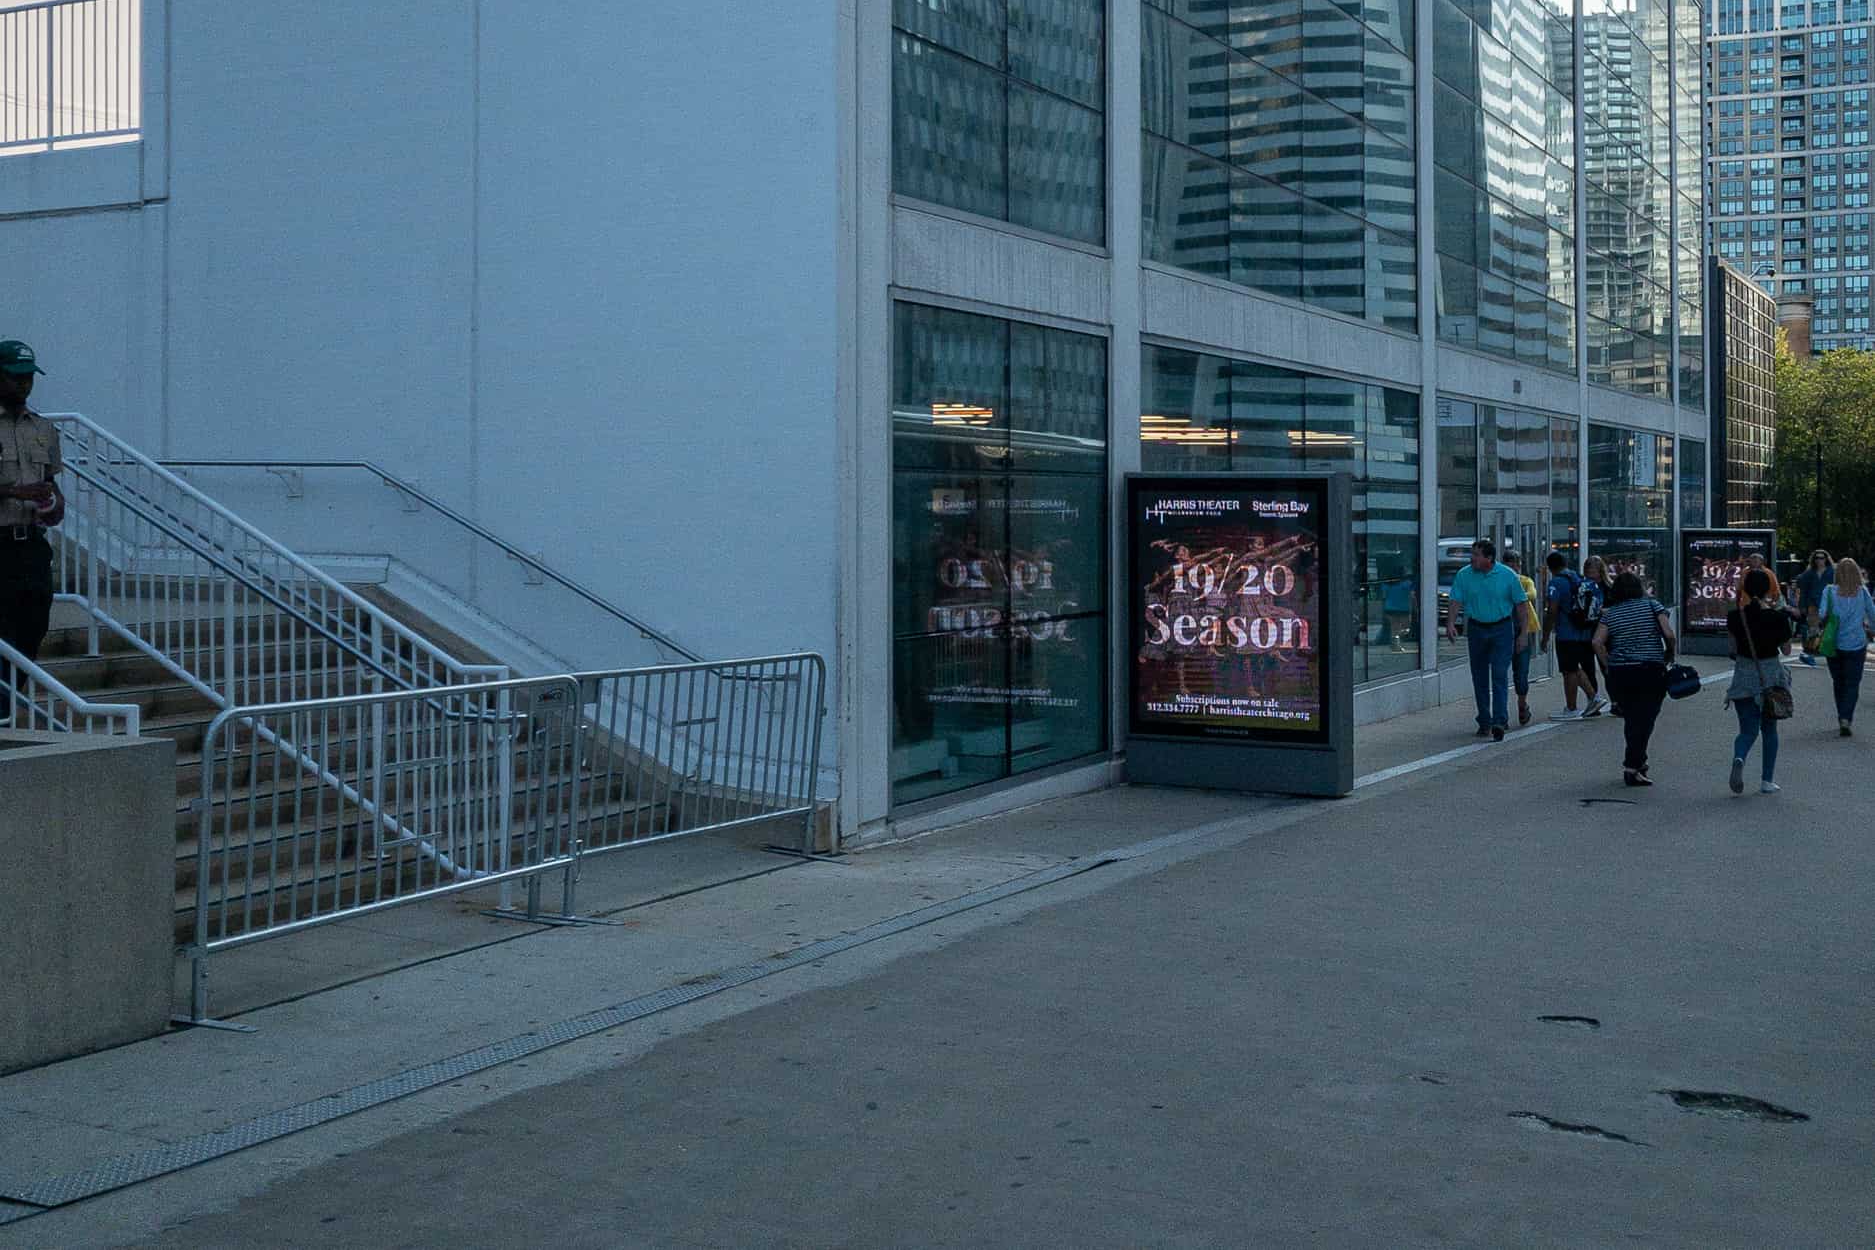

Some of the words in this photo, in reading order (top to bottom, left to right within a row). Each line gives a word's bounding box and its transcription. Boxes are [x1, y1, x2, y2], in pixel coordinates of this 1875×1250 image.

[1158, 499, 1197, 510] HARRIS
[1198, 500, 1240, 510] THEATER
[1290, 500, 1310, 513] Bay
[1168, 552, 1295, 601] 19/20
[1702, 560, 1741, 581] 19/2
[1690, 580, 1737, 599] Seas
[1144, 602, 1312, 650] Season
[1175, 694, 1230, 707] Subscriptions
[1232, 698, 1249, 706] now
[1263, 698, 1280, 708] sale
[1209, 705, 1311, 721] harristheaterchicago.org
